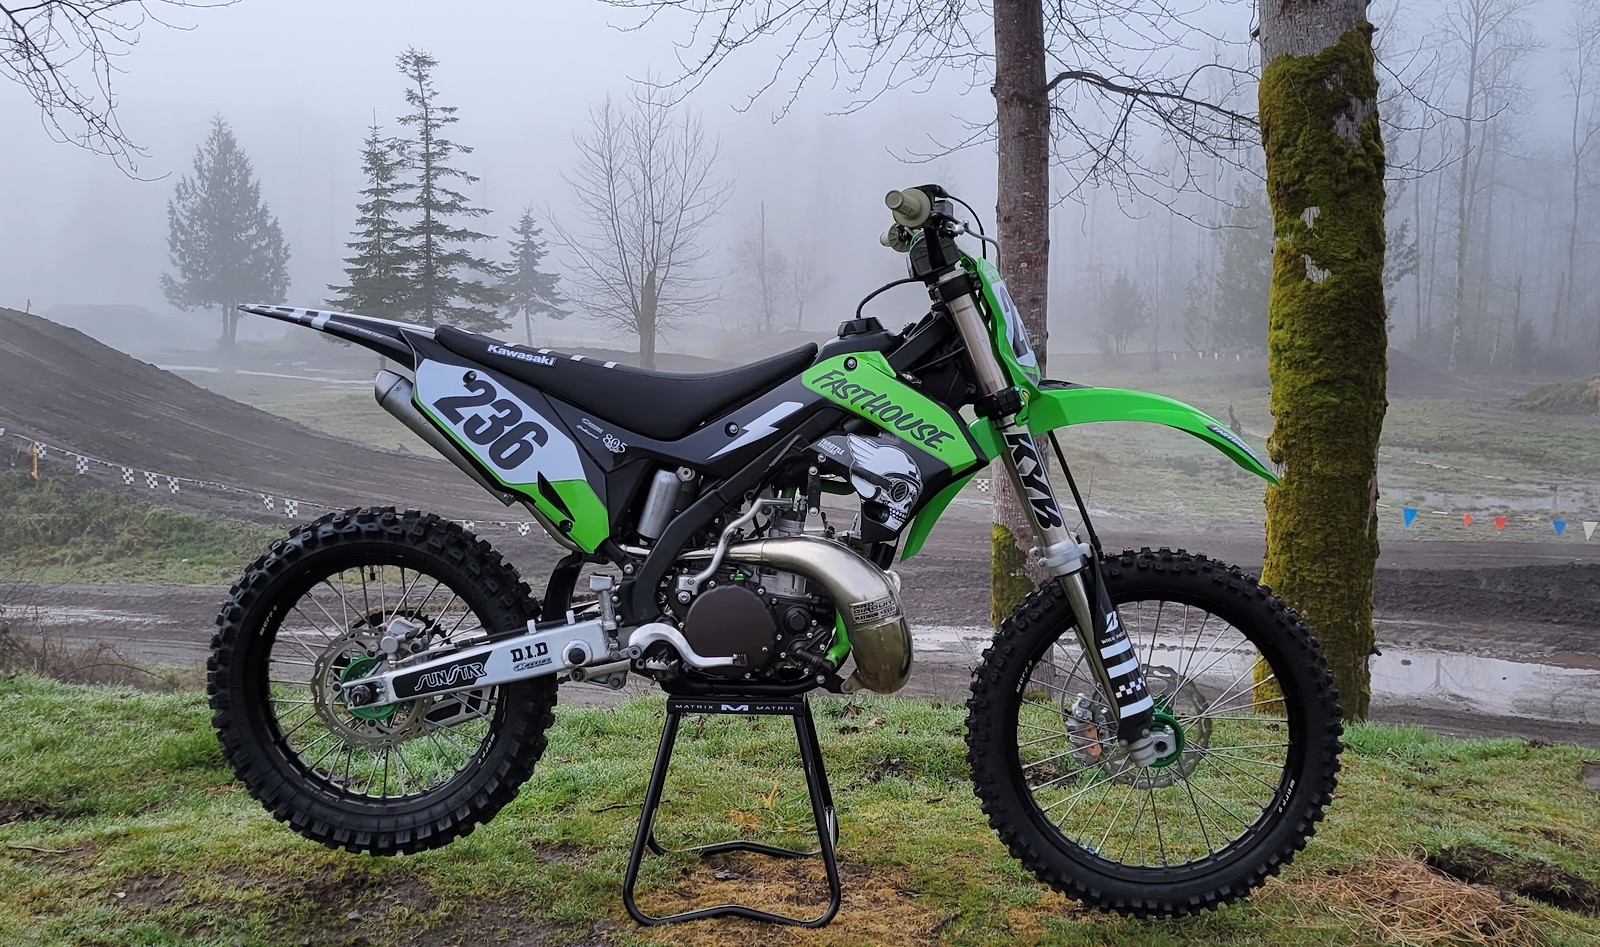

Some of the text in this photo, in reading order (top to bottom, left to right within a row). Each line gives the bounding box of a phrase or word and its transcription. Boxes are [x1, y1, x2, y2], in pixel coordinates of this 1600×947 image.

[487, 344, 555, 367] Kawasaki
[811, 369, 956, 450] FASTHOUSE
[432, 379, 549, 471] 236
[602, 433, 628, 454] 805
[1003, 432, 1063, 530] KYB
[510, 641, 549, 663] D.I.D
[414, 662, 487, 692] SUNSTAR
